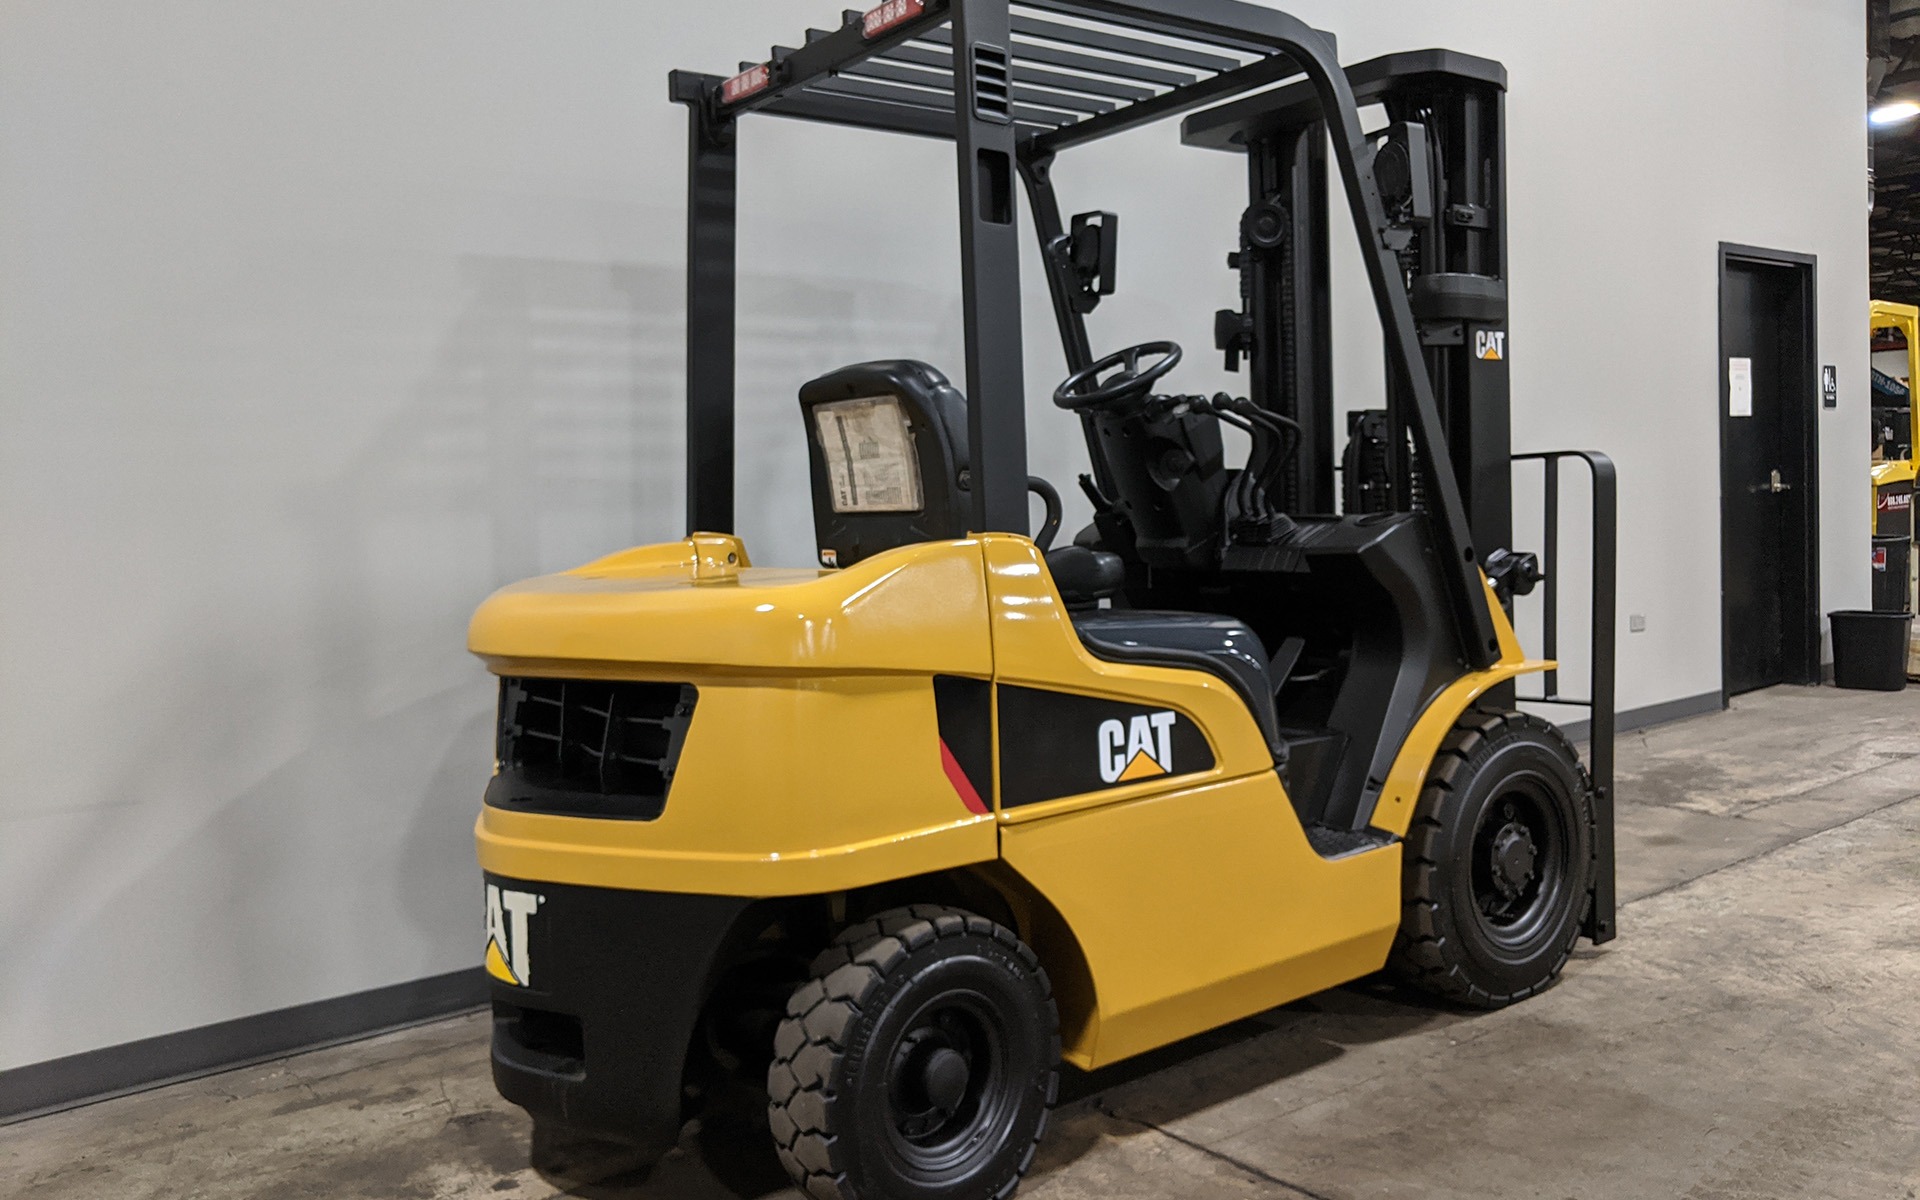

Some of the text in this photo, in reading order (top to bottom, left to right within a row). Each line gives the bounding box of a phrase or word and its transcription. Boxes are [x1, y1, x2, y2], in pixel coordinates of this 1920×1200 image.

[1475, 330, 1504, 360] CAT
[1098, 711, 1176, 783] CAT
[486, 884, 538, 988] AT
